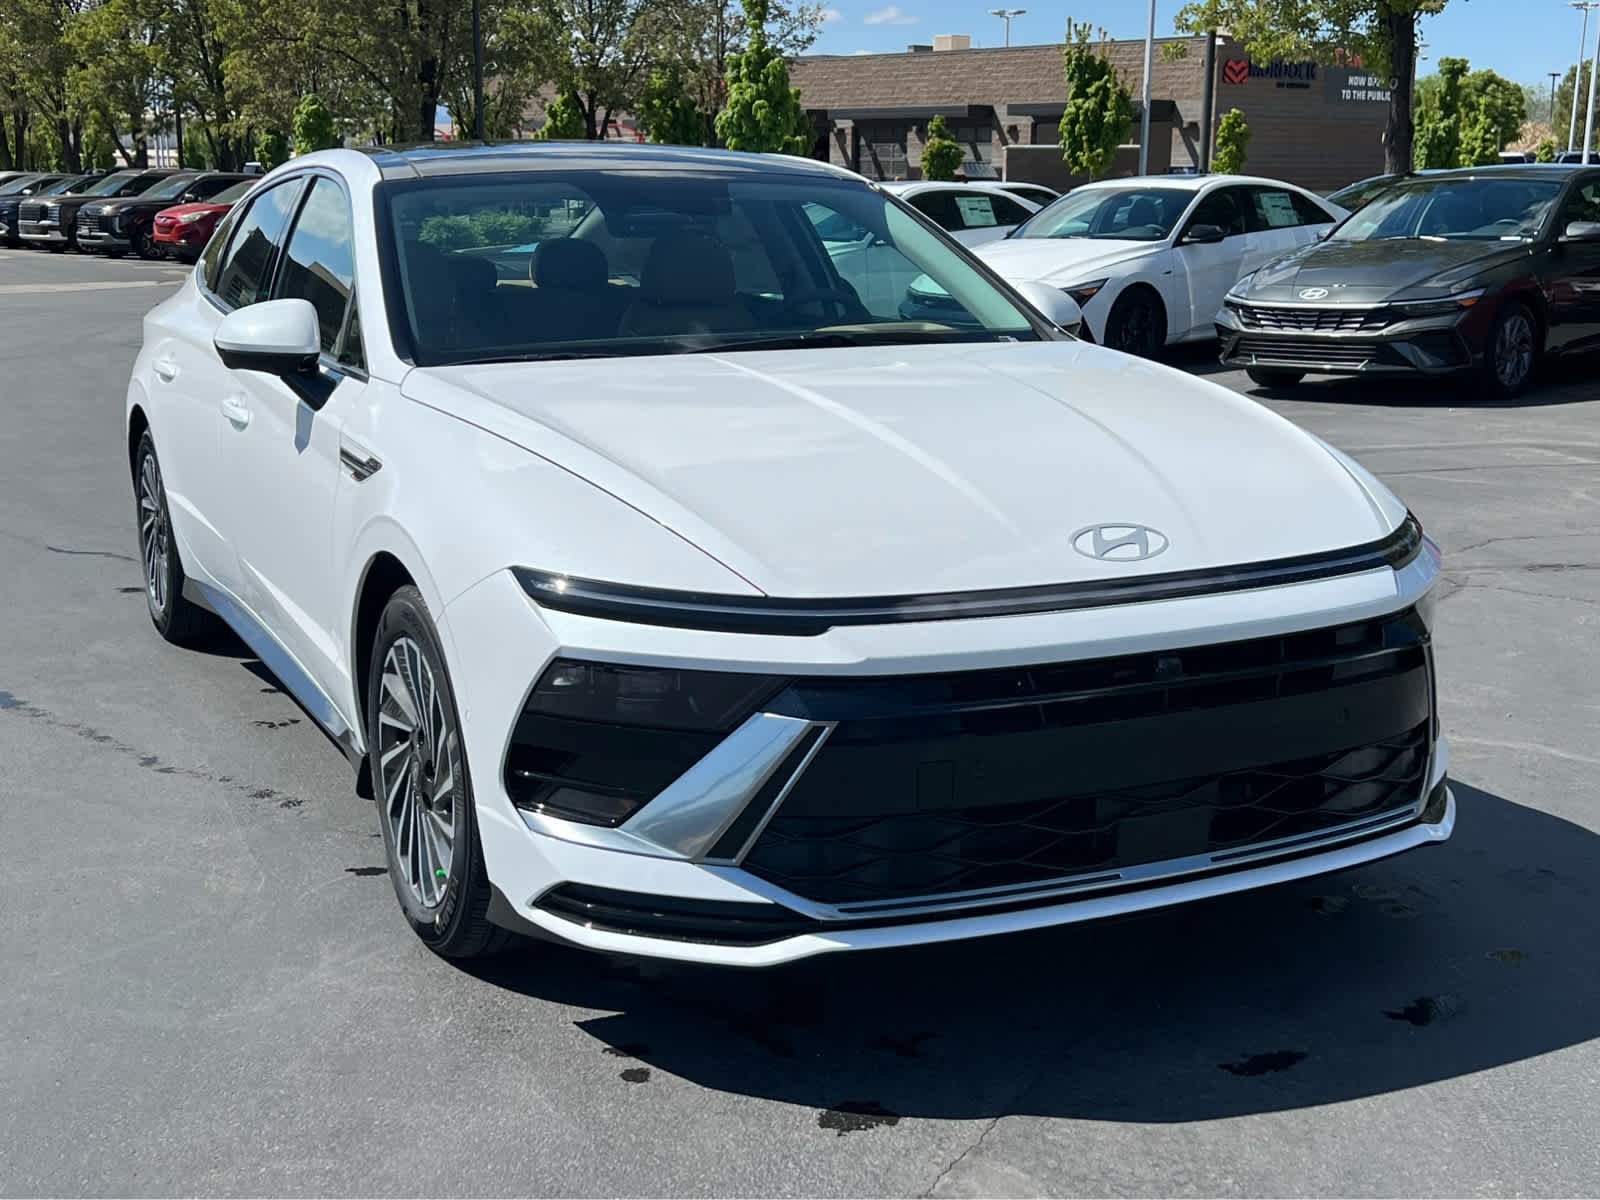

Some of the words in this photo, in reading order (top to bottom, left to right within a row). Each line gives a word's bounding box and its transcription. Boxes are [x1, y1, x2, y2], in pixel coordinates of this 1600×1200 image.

[1348, 75, 1366, 86] NOW
[1341, 89, 1351, 100] TO
[1352, 90, 1366, 101] THE
[1367, 90, 1391, 102] PUBLIC
